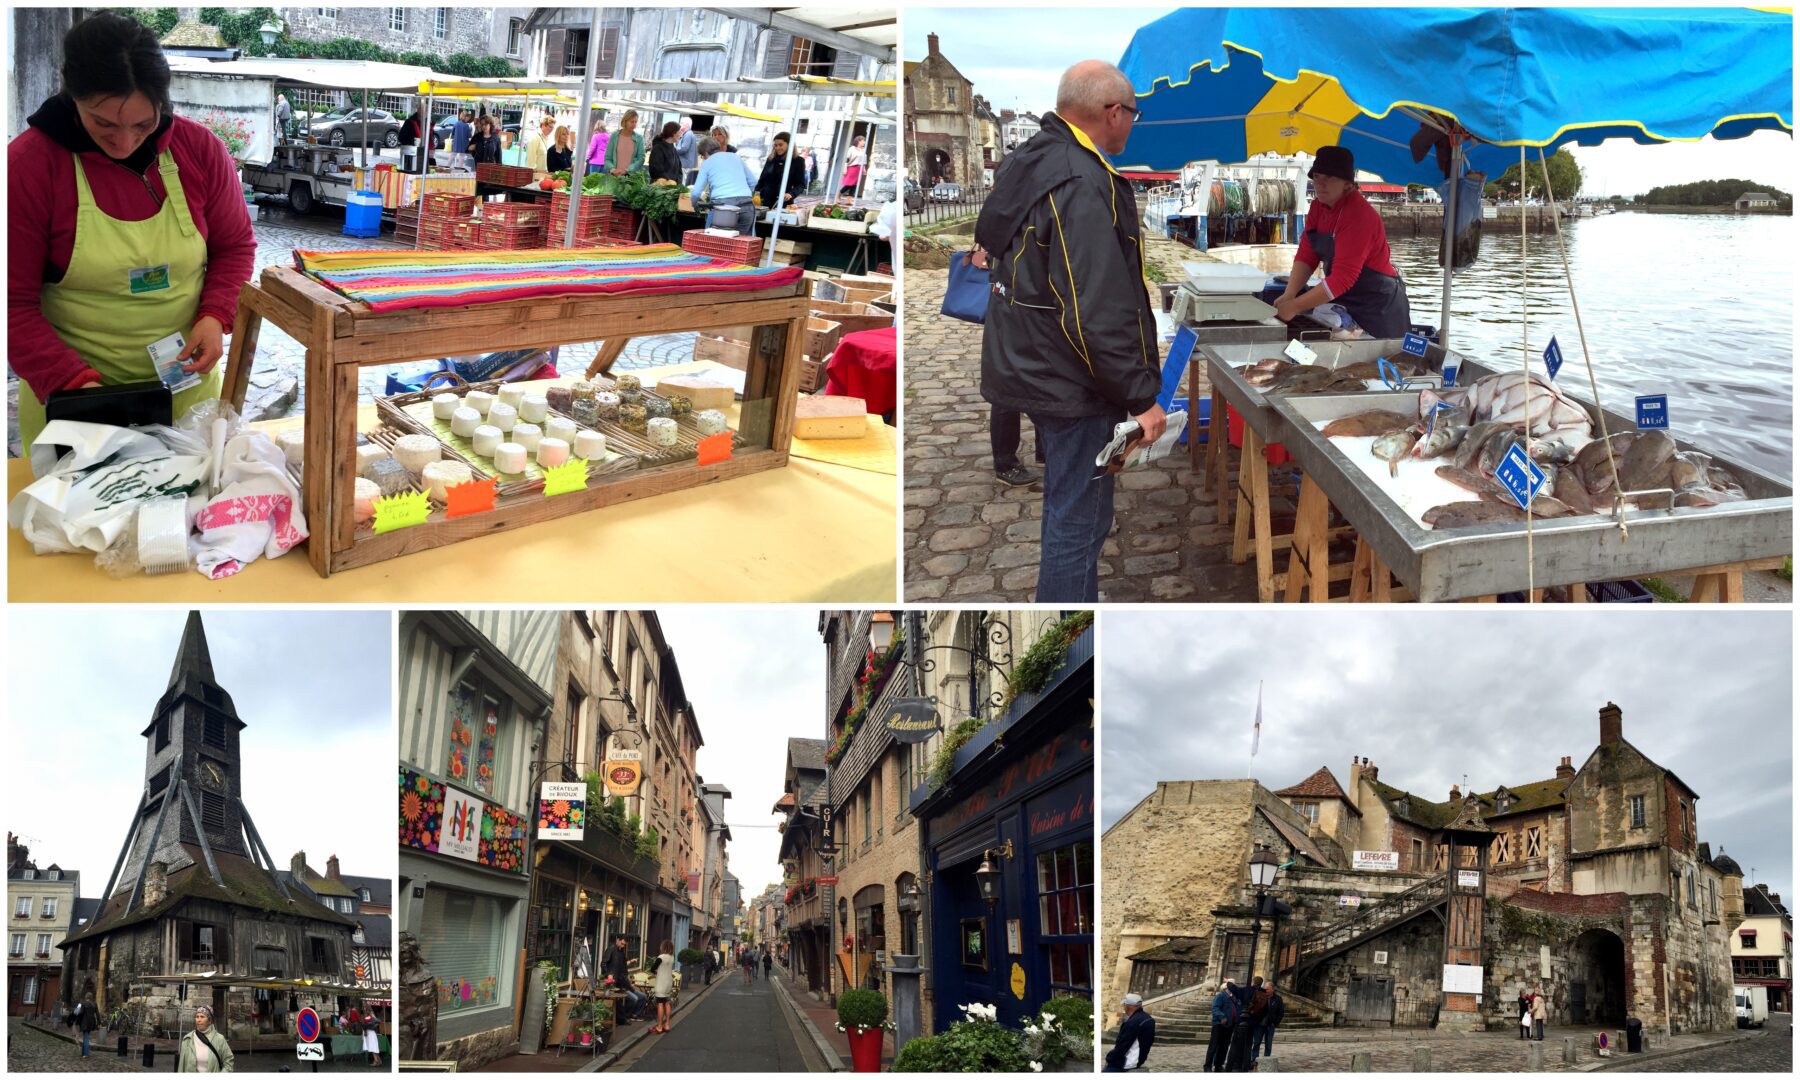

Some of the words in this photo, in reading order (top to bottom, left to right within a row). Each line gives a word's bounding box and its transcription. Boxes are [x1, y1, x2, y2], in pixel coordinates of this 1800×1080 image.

[886, 711, 938, 731] Restaurant
[823, 807, 831, 837] CUIR
[1360, 852, 1392, 861] LEFEVRE
